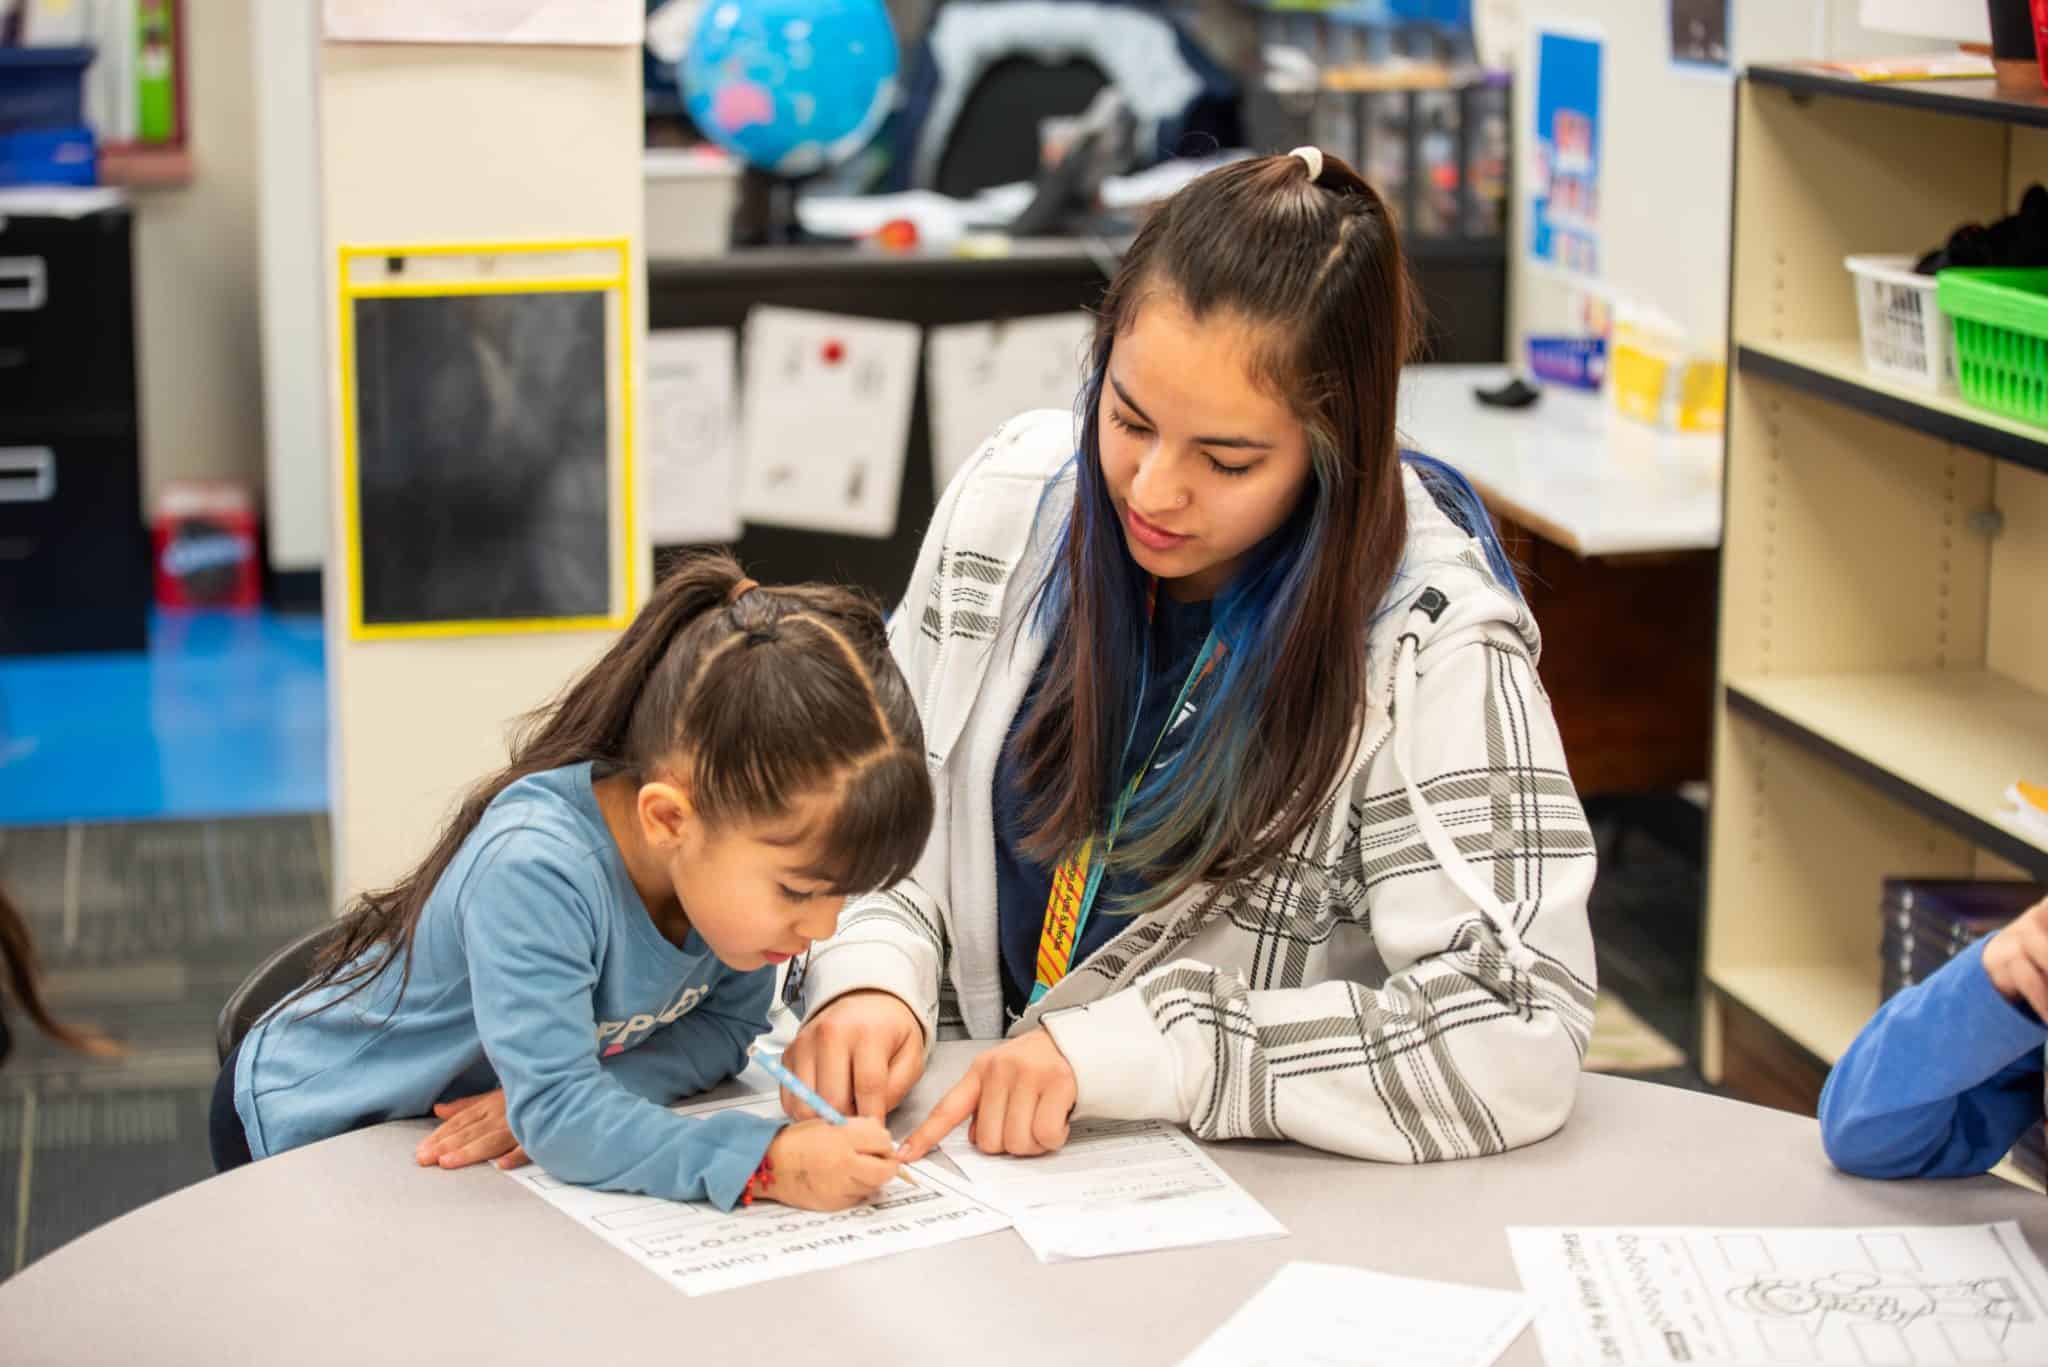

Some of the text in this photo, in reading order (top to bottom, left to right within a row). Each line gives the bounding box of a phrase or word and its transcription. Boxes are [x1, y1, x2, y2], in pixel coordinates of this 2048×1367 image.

[671, 1206, 985, 1276] Label the Winter Clothes
